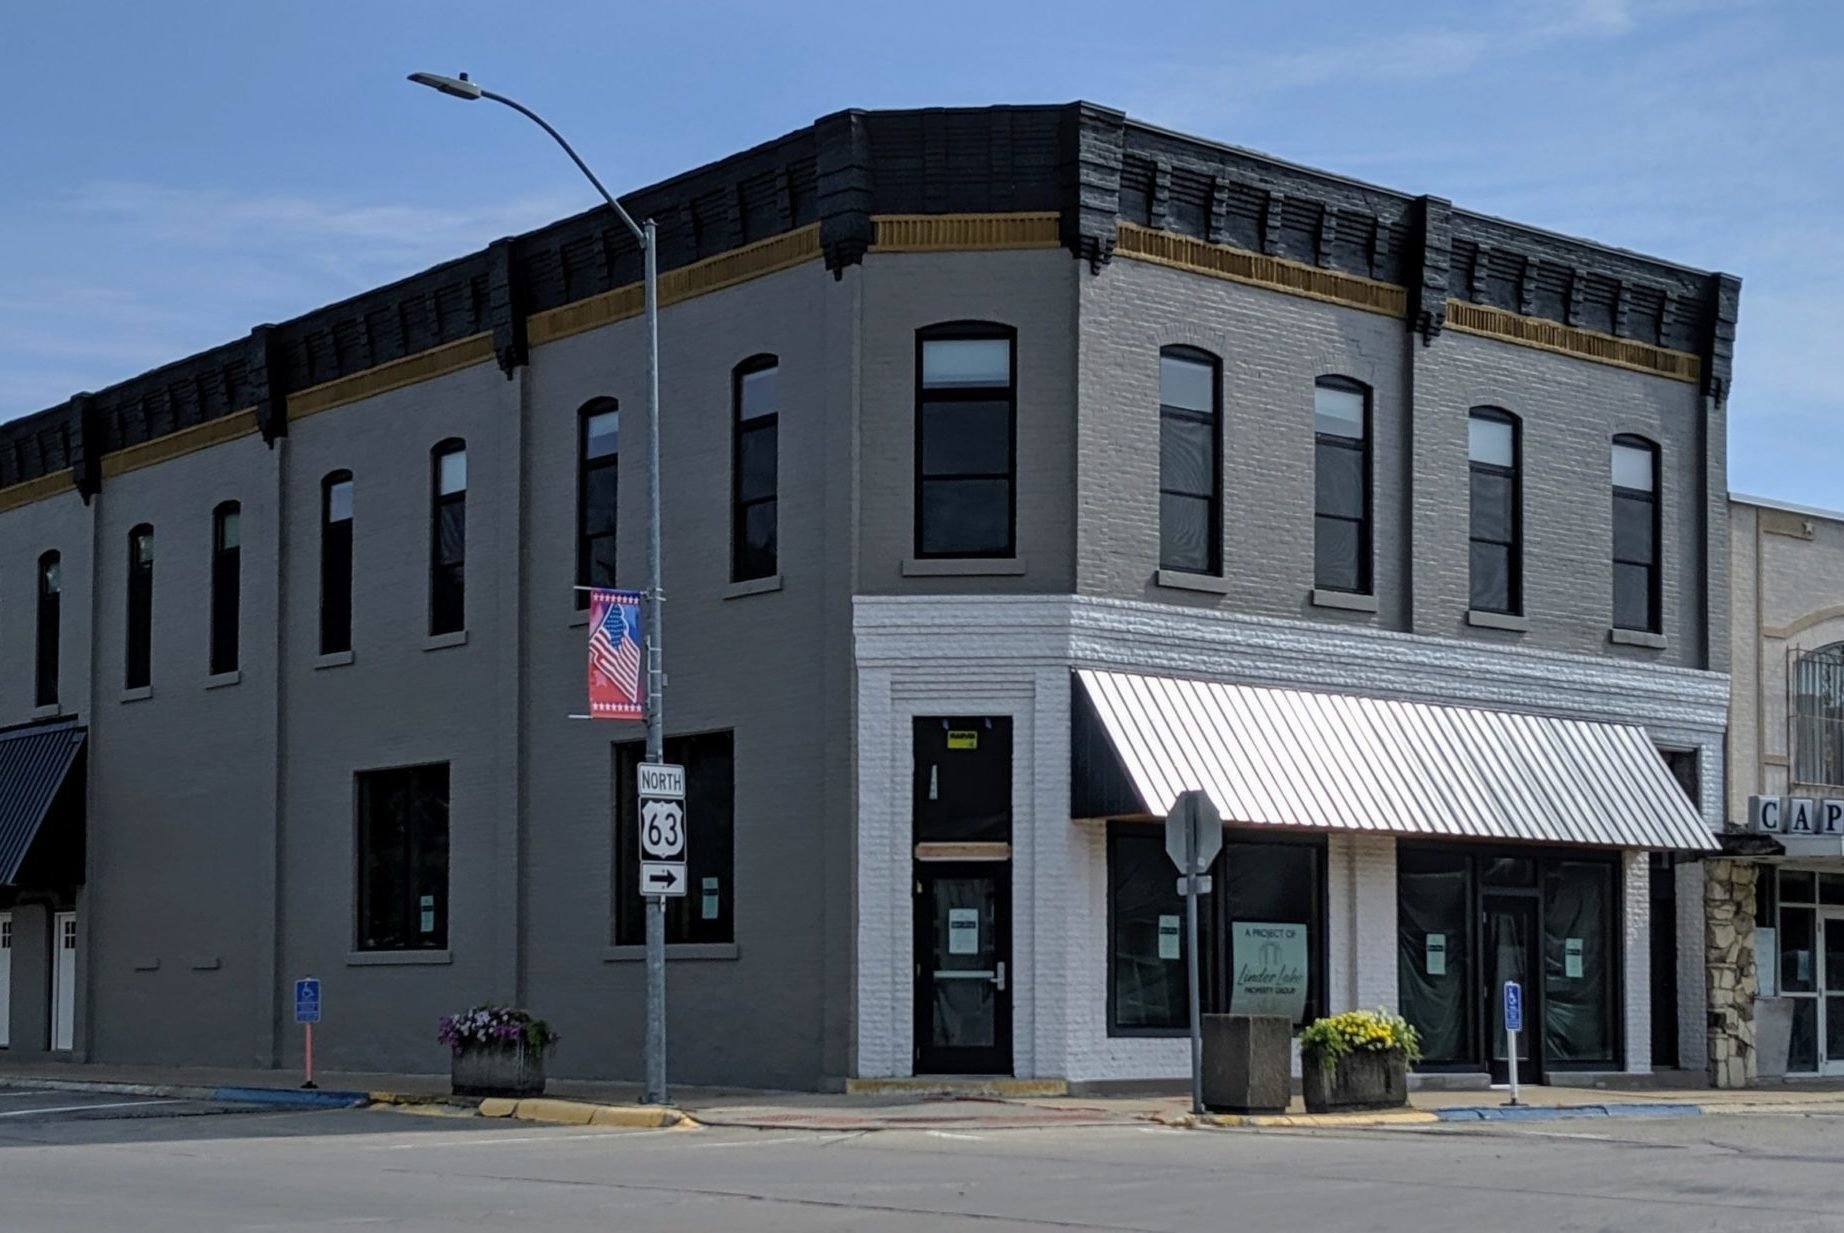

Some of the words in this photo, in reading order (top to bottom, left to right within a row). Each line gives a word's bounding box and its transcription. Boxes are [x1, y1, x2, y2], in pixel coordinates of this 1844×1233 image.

[642, 770, 682, 791] NORTH
[648, 812, 678, 846] 63
[1762, 802, 1842, 831] CAP
[1245, 928, 1251, 937] A
[1253, 928, 1284, 939] PROJECT
[1286, 929, 1296, 938] OF
